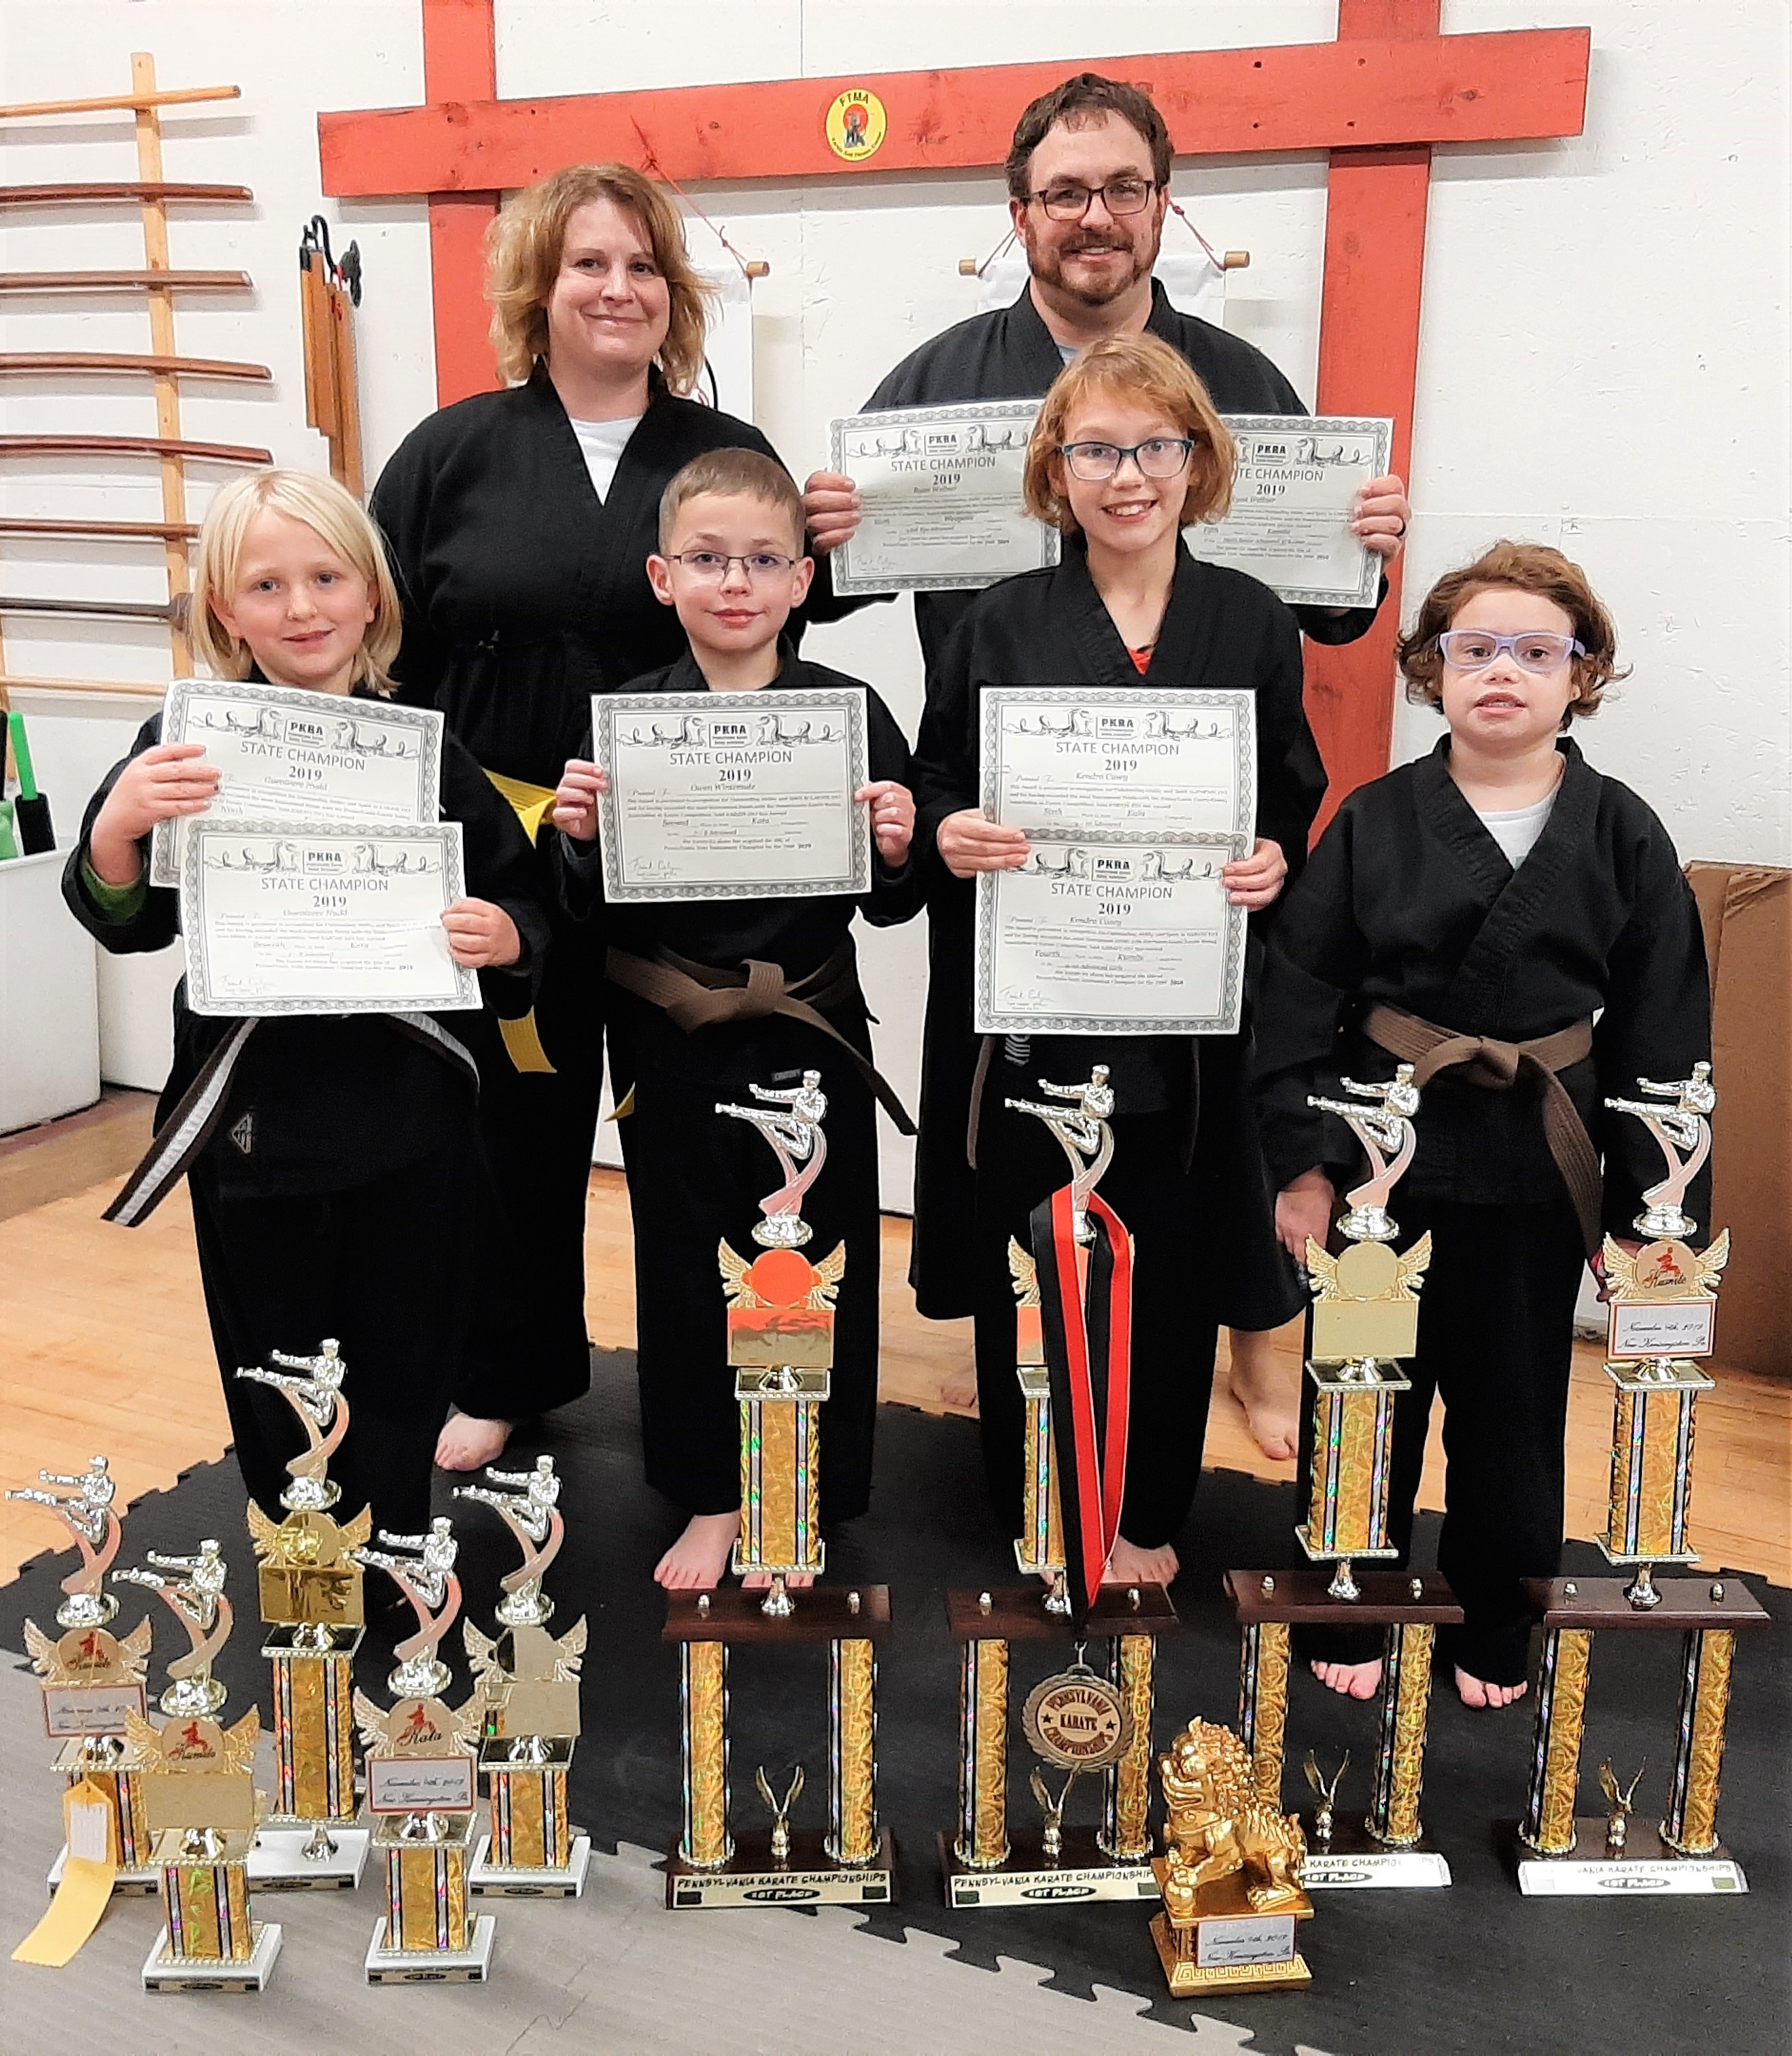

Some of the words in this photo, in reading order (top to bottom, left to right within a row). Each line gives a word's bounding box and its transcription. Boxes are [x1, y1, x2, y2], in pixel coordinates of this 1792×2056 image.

[891, 460, 926, 472] STATE
[929, 457, 996, 470] CHAMPION
[933, 474, 961, 485] 2019
[1255, 469, 1324, 481] CHAMPION
[1256, 483, 1286, 496] 2019
[240, 740, 283, 759] STATE
[288, 748, 366, 771] CHAMPION
[1056, 742, 1097, 754] STATE
[1101, 742, 1179, 756] CHAMPION
[670, 753, 711, 766] STATE
[715, 751, 793, 764] CHAMPION
[1105, 759, 1137, 772] 2019
[288, 766, 323, 781] 2019
[719, 769, 752, 781] 2019
[262, 878, 305, 891] STATE
[309, 878, 389, 891] CHAMPION
[1051, 883, 1092, 897] STATE
[1096, 885, 1173, 900] CHAMPION
[313, 895, 347, 908] 2019
[1098, 902, 1131, 915] 2019
[1060, 1713, 1098, 1731] KARATE
[1309, 1859, 1349, 1868] KARATE
[1608, 1865, 1645, 1874] KARATE
[676, 1877, 755, 1888] PENNSYLVANIA
[758, 1875, 798, 1885] KARATE
[801, 1872, 887, 1885] CHAMPIONSHIPS
[954, 1875, 1030, 1887] PENNSYLVANIA
[1034, 1874, 1073, 1884] KARATE
[1075, 1869, 1154, 1882] CHAMPIONSHIP
[1328, 1873, 1366, 1881] PLACE
[1627, 1879, 1665, 1887] PLACE
[775, 1889, 814, 1899] PLACE
[1052, 1887, 1090, 1896] PLACE
